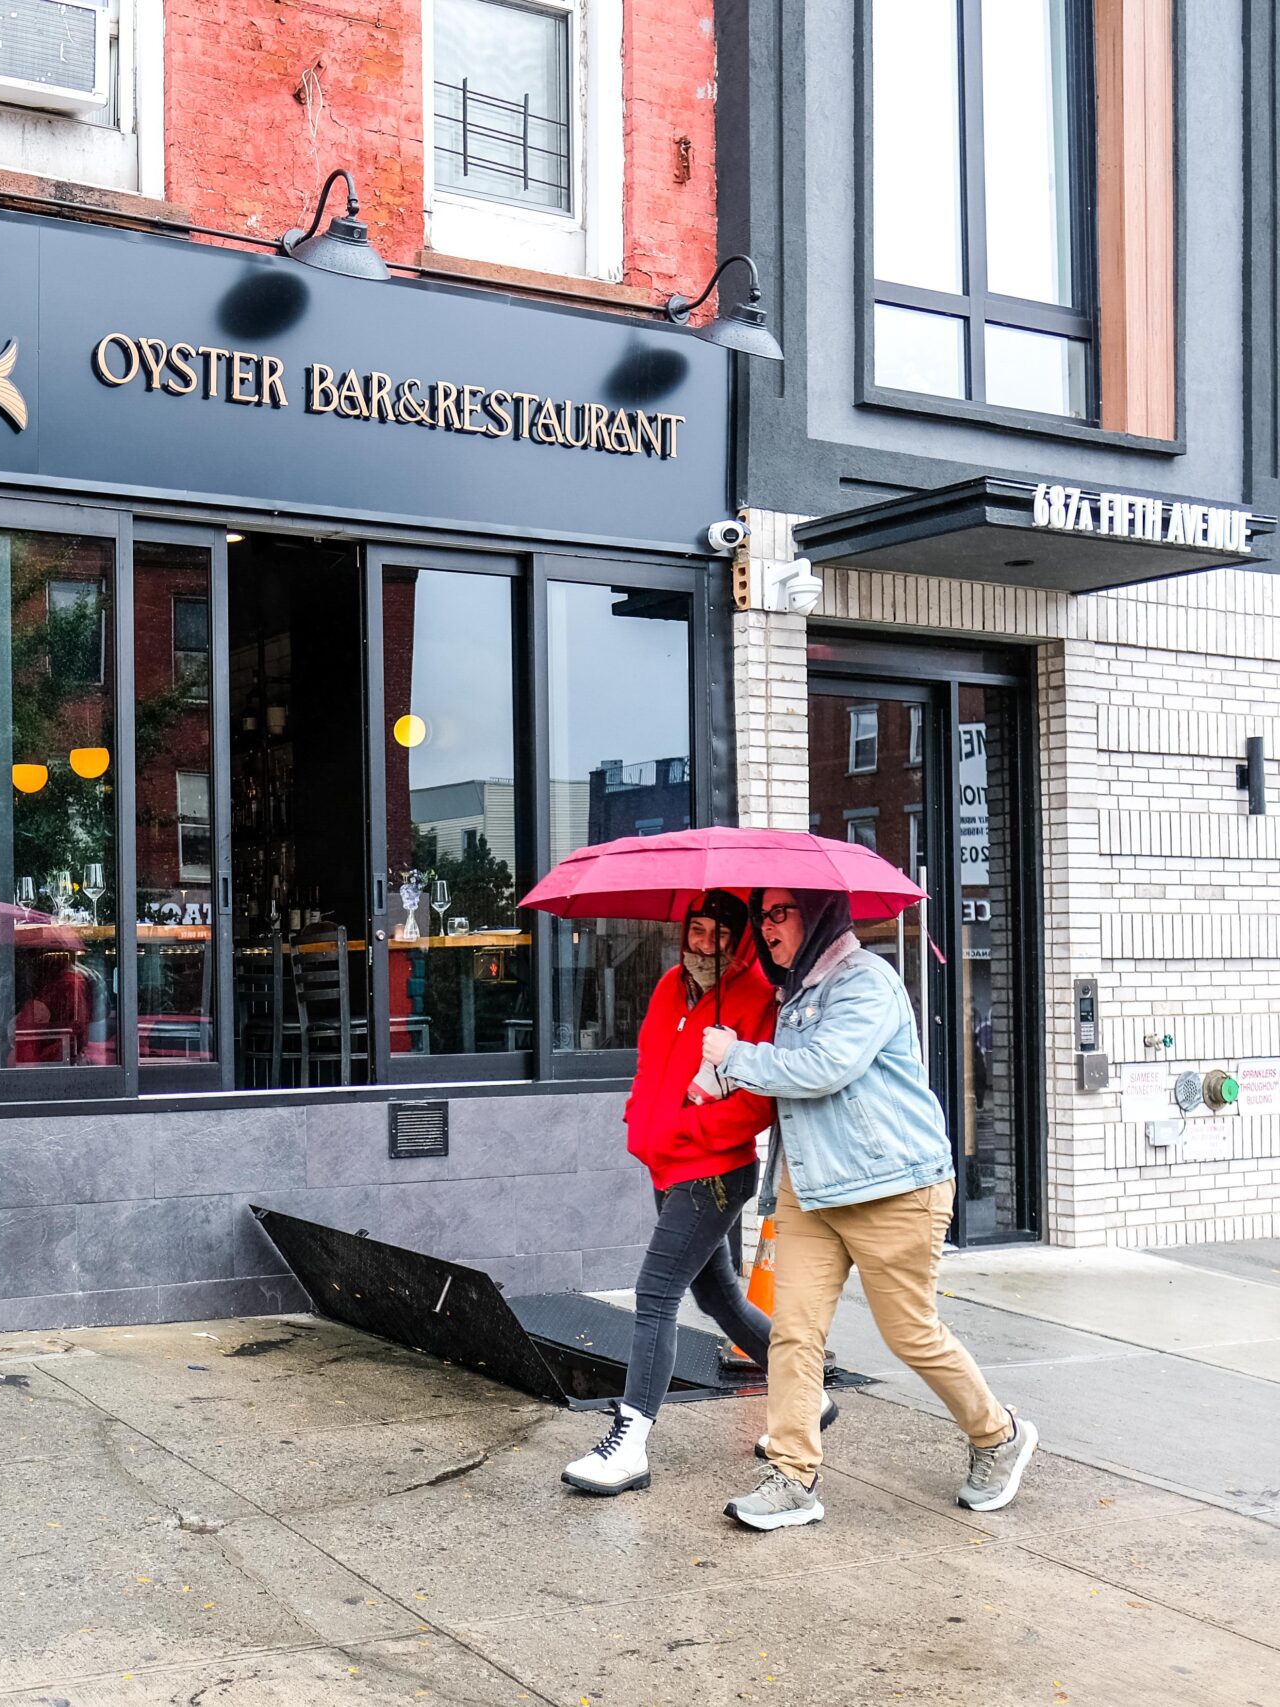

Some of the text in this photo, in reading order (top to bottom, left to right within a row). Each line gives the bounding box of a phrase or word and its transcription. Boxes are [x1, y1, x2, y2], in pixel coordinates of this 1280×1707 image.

[97, 332, 289, 406] OYSTER
[1097, 492, 1162, 542] FIFTH
[1164, 502, 1252, 553] AVENUE
[1130, 1072, 1159, 1083] SIAMESE
